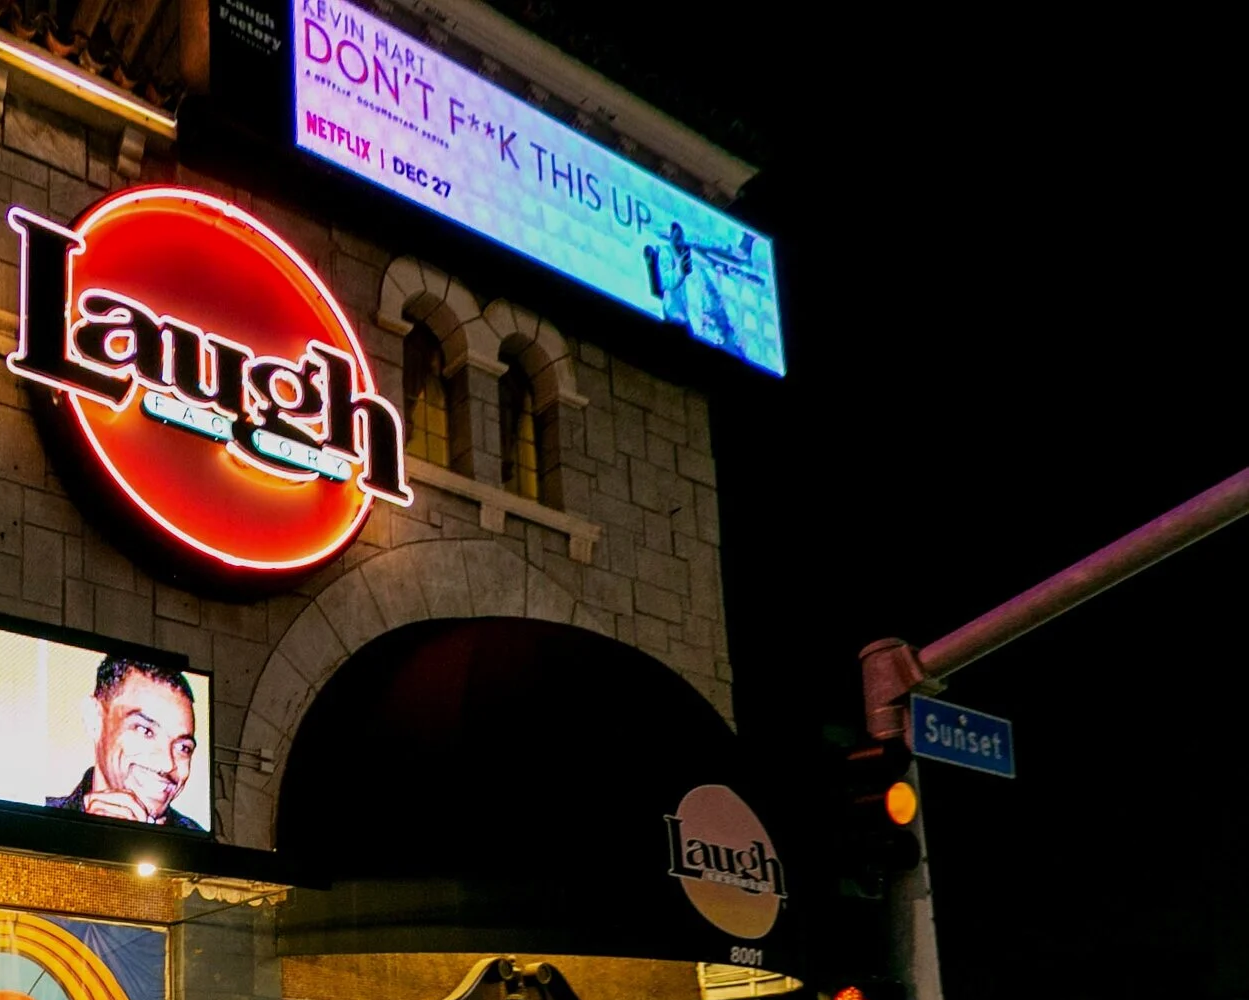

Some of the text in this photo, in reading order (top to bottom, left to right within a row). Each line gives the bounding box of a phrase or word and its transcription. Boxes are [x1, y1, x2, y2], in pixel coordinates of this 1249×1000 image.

[219, 5, 282, 51] Factory
[303, 0, 365, 43] KEVIN
[374, 32, 425, 76] HART
[305, 18, 435, 121] DON'T
[529, 141, 602, 212] THIS
[611, 186, 652, 234] UP
[306, 110, 452, 199] NETFLIX DEC 27
[7, 206, 414, 507] Laugh
[154, 395, 344, 474] FACTORY
[924, 713, 1003, 760] Sunset
[663, 814, 789, 899] Laugh
[730, 945, 764, 966] 8001
